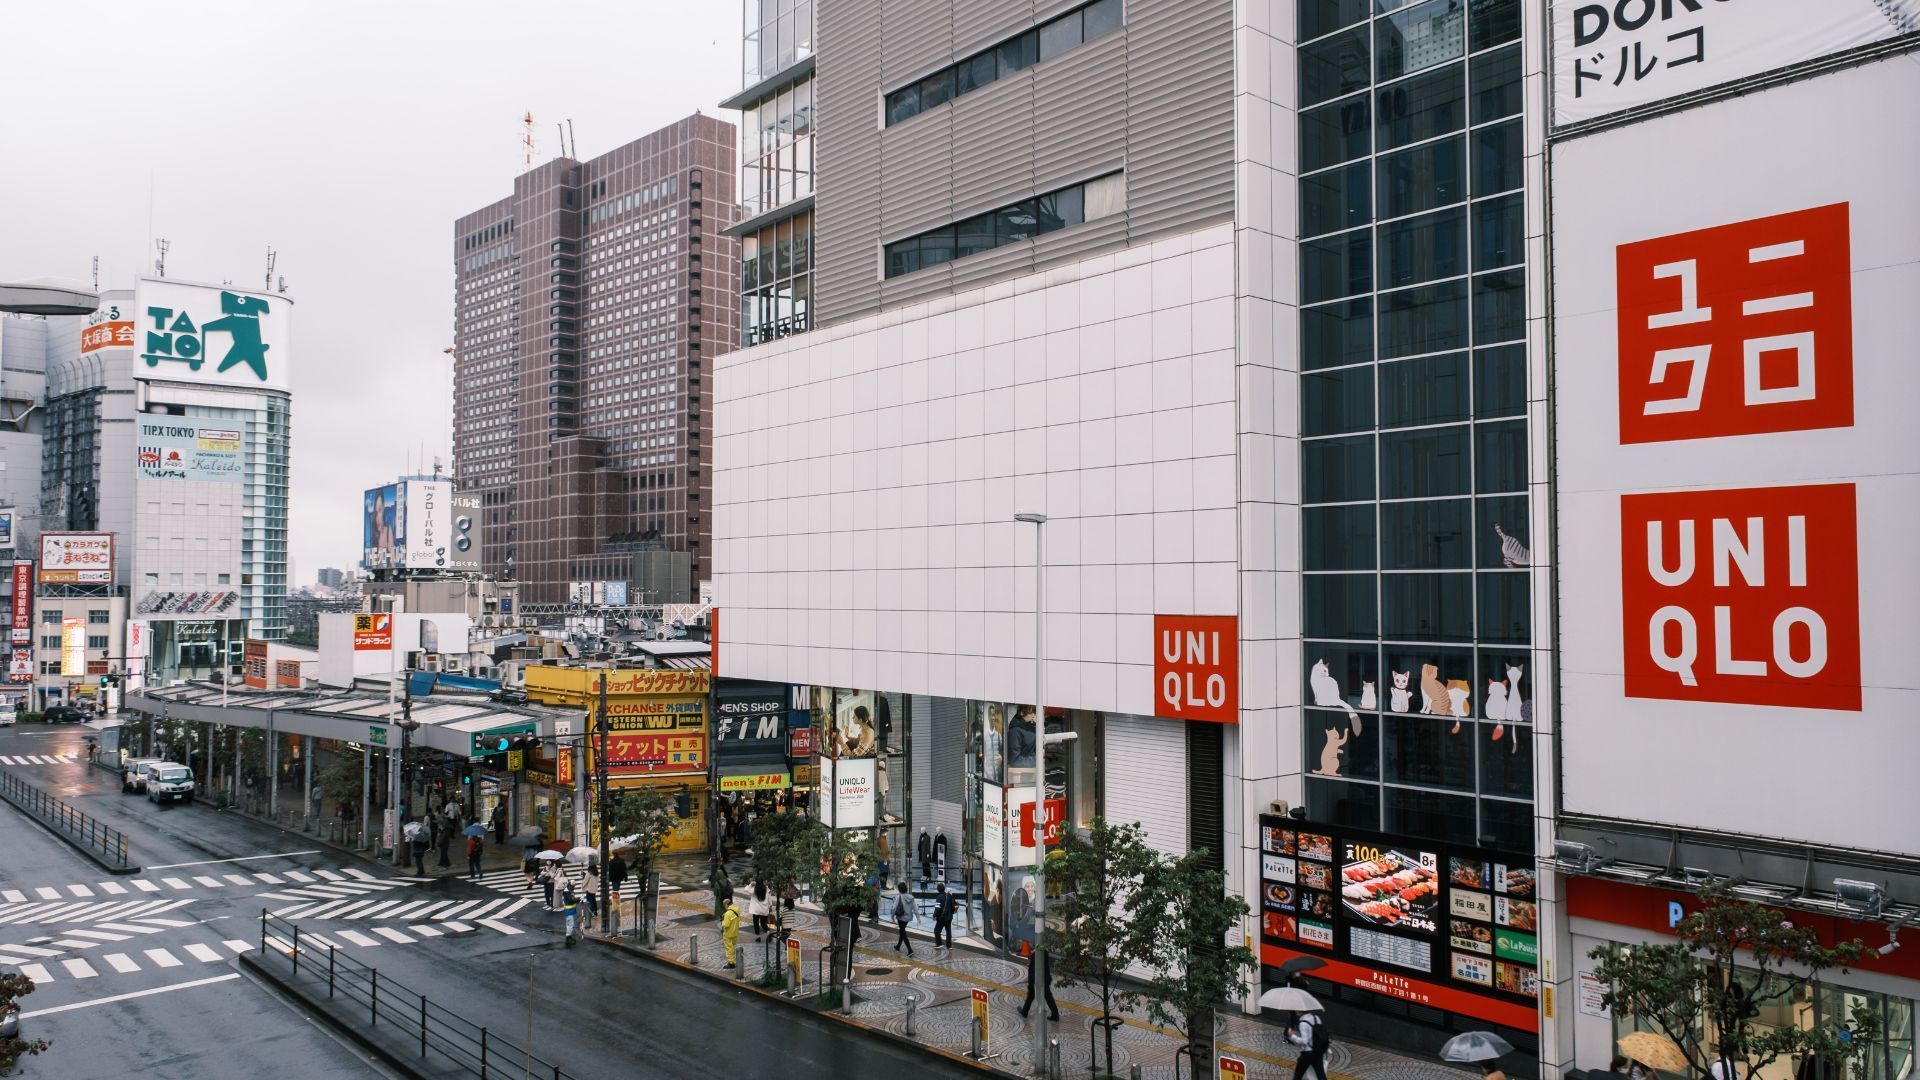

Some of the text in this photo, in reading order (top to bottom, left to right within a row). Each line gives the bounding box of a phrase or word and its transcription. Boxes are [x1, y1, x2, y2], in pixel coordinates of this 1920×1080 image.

[1575, 25, 1704, 98] ドルコ
[1643, 330, 1816, 416] クロ
[142, 425, 165, 437] TIP.X
[166, 427, 195, 438] TOKYO
[1646, 514, 1807, 587] UNI
[63, 552, 108, 564] まねきねこ
[356, 616, 371, 630] 薬
[1163, 630, 1219, 666] UNI
[1648, 605, 1828, 687] QLO
[1163, 671, 1226, 711] QLO
[750, 702, 780, 712] SHOP
[607, 715, 673, 730] ESTERN WU
[612, 722, 643, 730] UNION
[718, 715, 779, 741] FIM
[723, 774, 782, 787] men's FIM
[839, 777, 866, 786] UNIQLO
[839, 786, 871, 795] LifeWear
[1421, 855, 1435, 867] 8F
[1373, 972, 1409, 989] PaLeTTe
